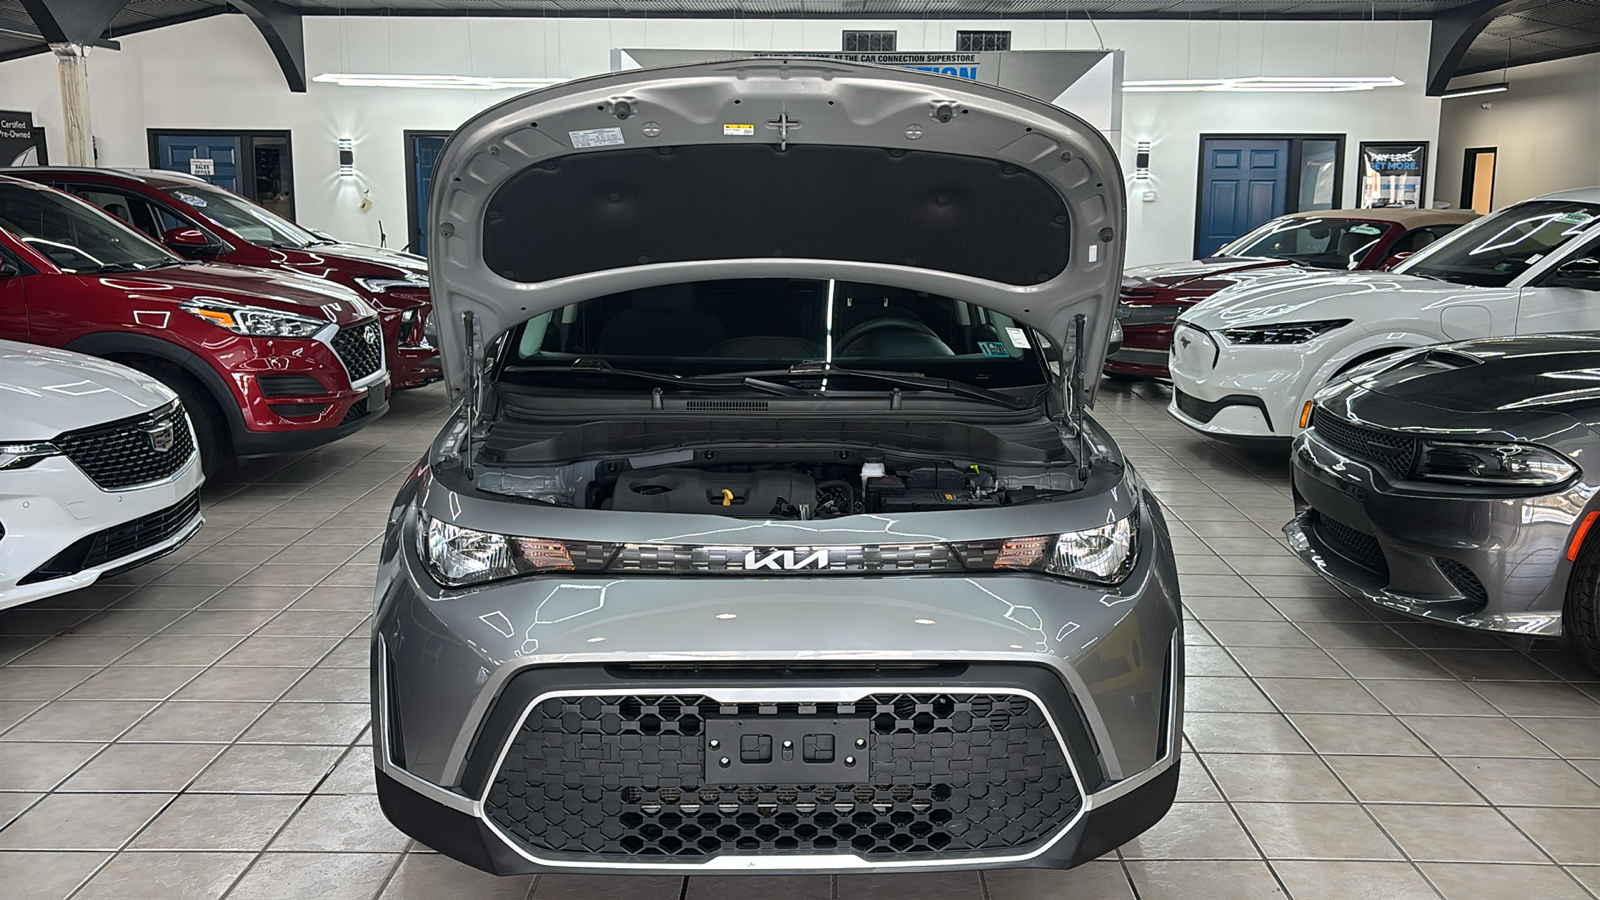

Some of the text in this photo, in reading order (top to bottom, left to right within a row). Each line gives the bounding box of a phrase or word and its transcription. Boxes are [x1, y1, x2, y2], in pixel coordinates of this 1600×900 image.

[927, 54, 976, 62] SUPERSTORE
[1, 120, 26, 129] Certified
[1388, 161, 1419, 170] MORE.
[745, 549, 829, 570] KIA
